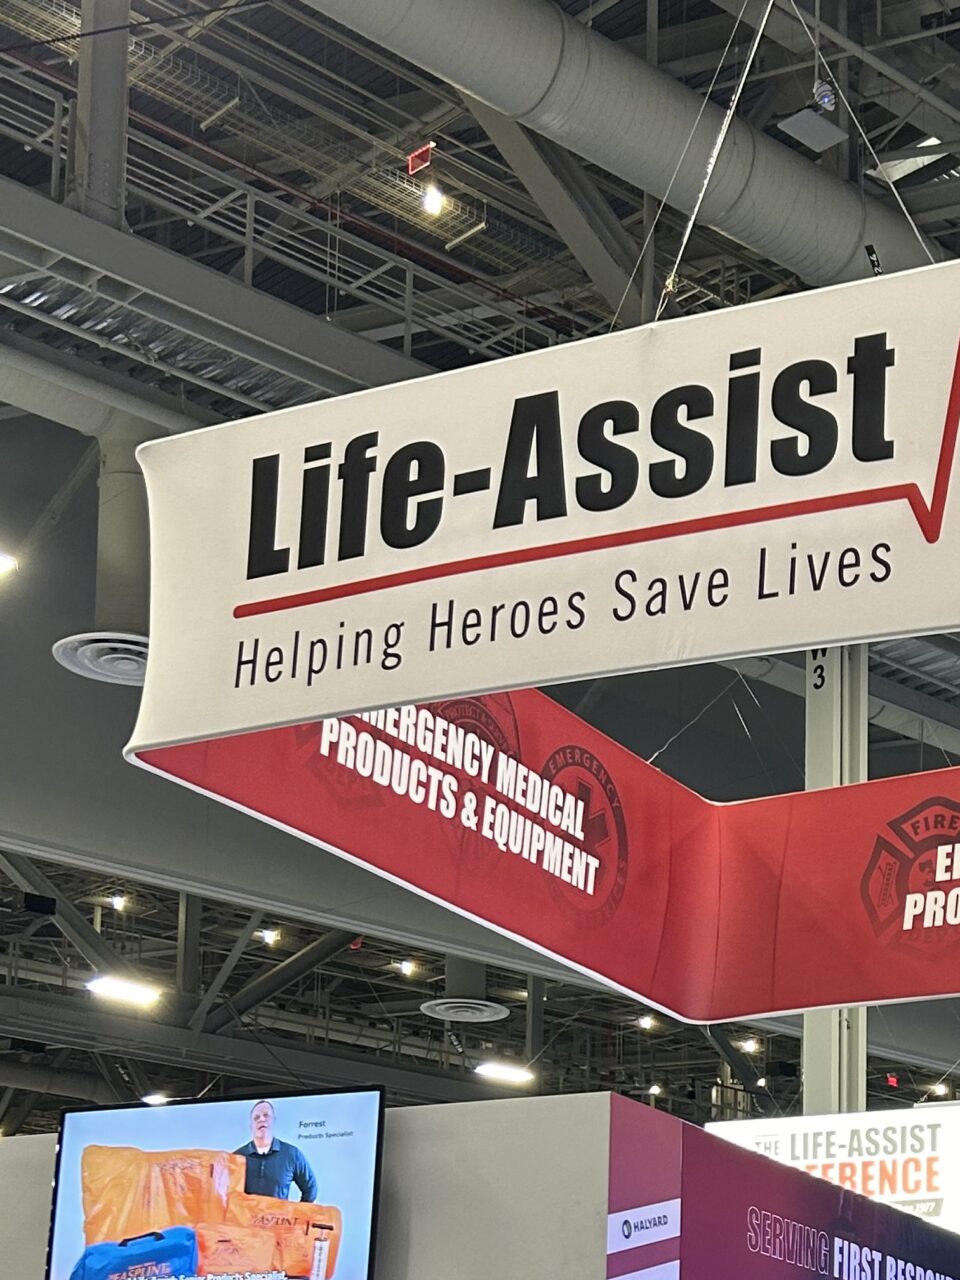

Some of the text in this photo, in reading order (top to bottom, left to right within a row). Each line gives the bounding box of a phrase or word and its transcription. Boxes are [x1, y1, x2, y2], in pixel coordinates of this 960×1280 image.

[246, 332, 895, 580] Life-Assist
[234, 541, 893, 688] Helping Heroes Save Lives
[812, 665, 826, 690] 3
[353, 704, 495, 784] MERGENCY
[496, 752, 585, 841] MEDICAL
[320, 717, 458, 820] PRODUCTS
[461, 791, 478, 832] &
[481, 795, 600, 896] EQUIPMENT
[910, 813, 960, 837] FIRE
[298, 1120, 326, 1129] Forrest
[755, 1123, 942, 1161] THE LIFE-ASSIST
[633, 1214, 669, 1233] HALYARD
[747, 1206, 829, 1275] SERVING
